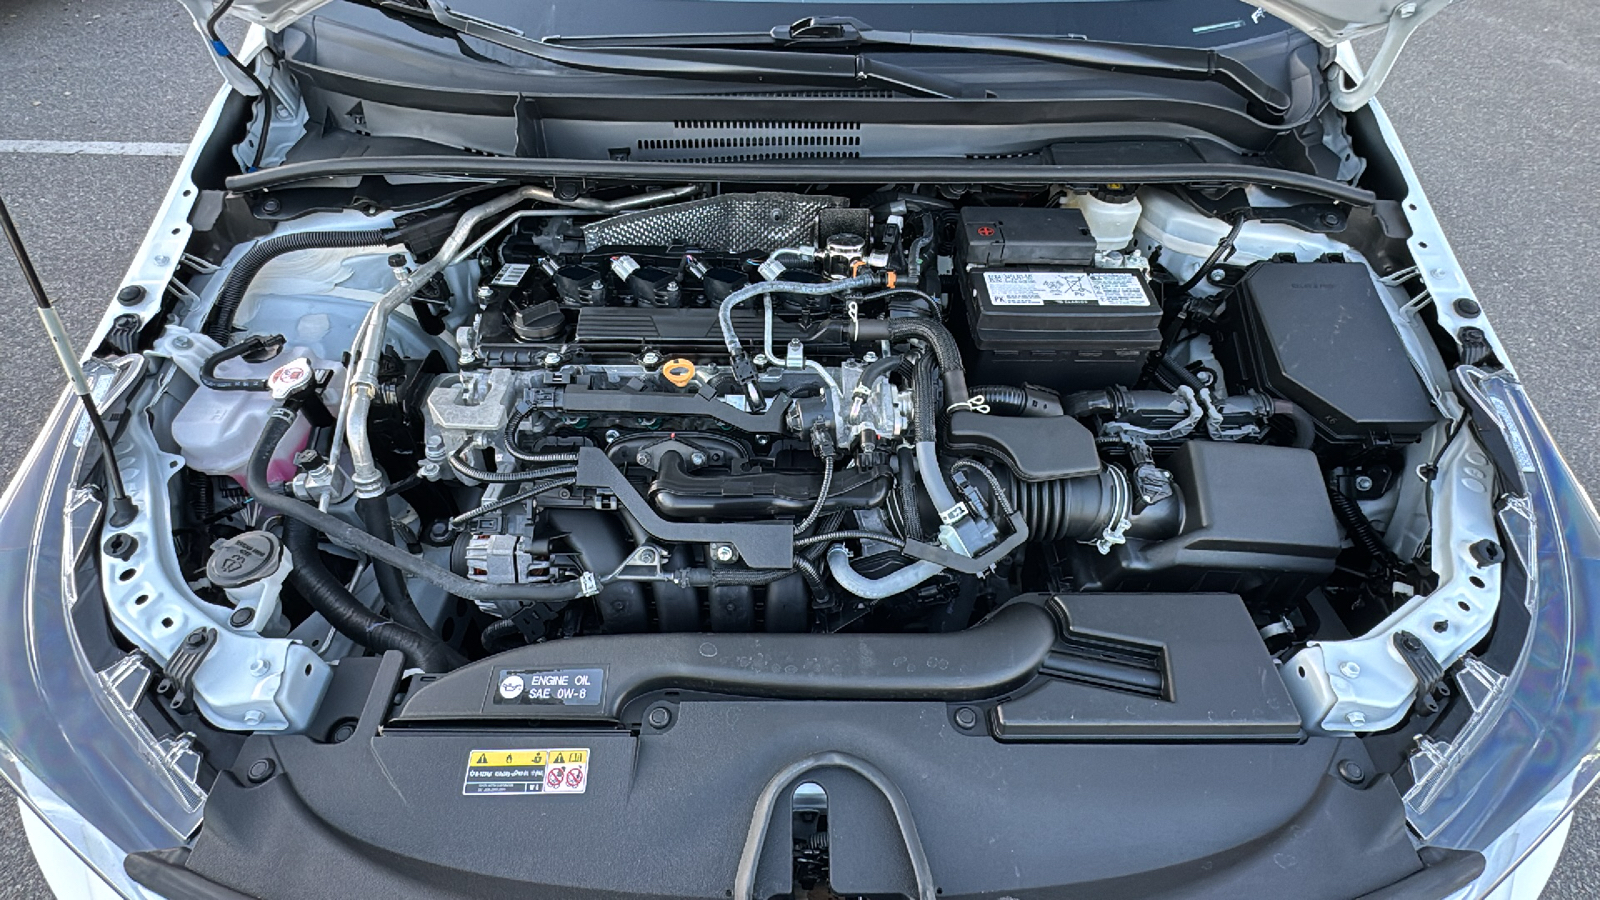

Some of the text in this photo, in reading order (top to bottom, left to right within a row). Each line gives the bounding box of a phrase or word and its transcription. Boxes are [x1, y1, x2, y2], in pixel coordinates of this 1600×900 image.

[531, 675, 591, 686] ENGINE OIL
[528, 688, 587, 699] SAE 0W-8
